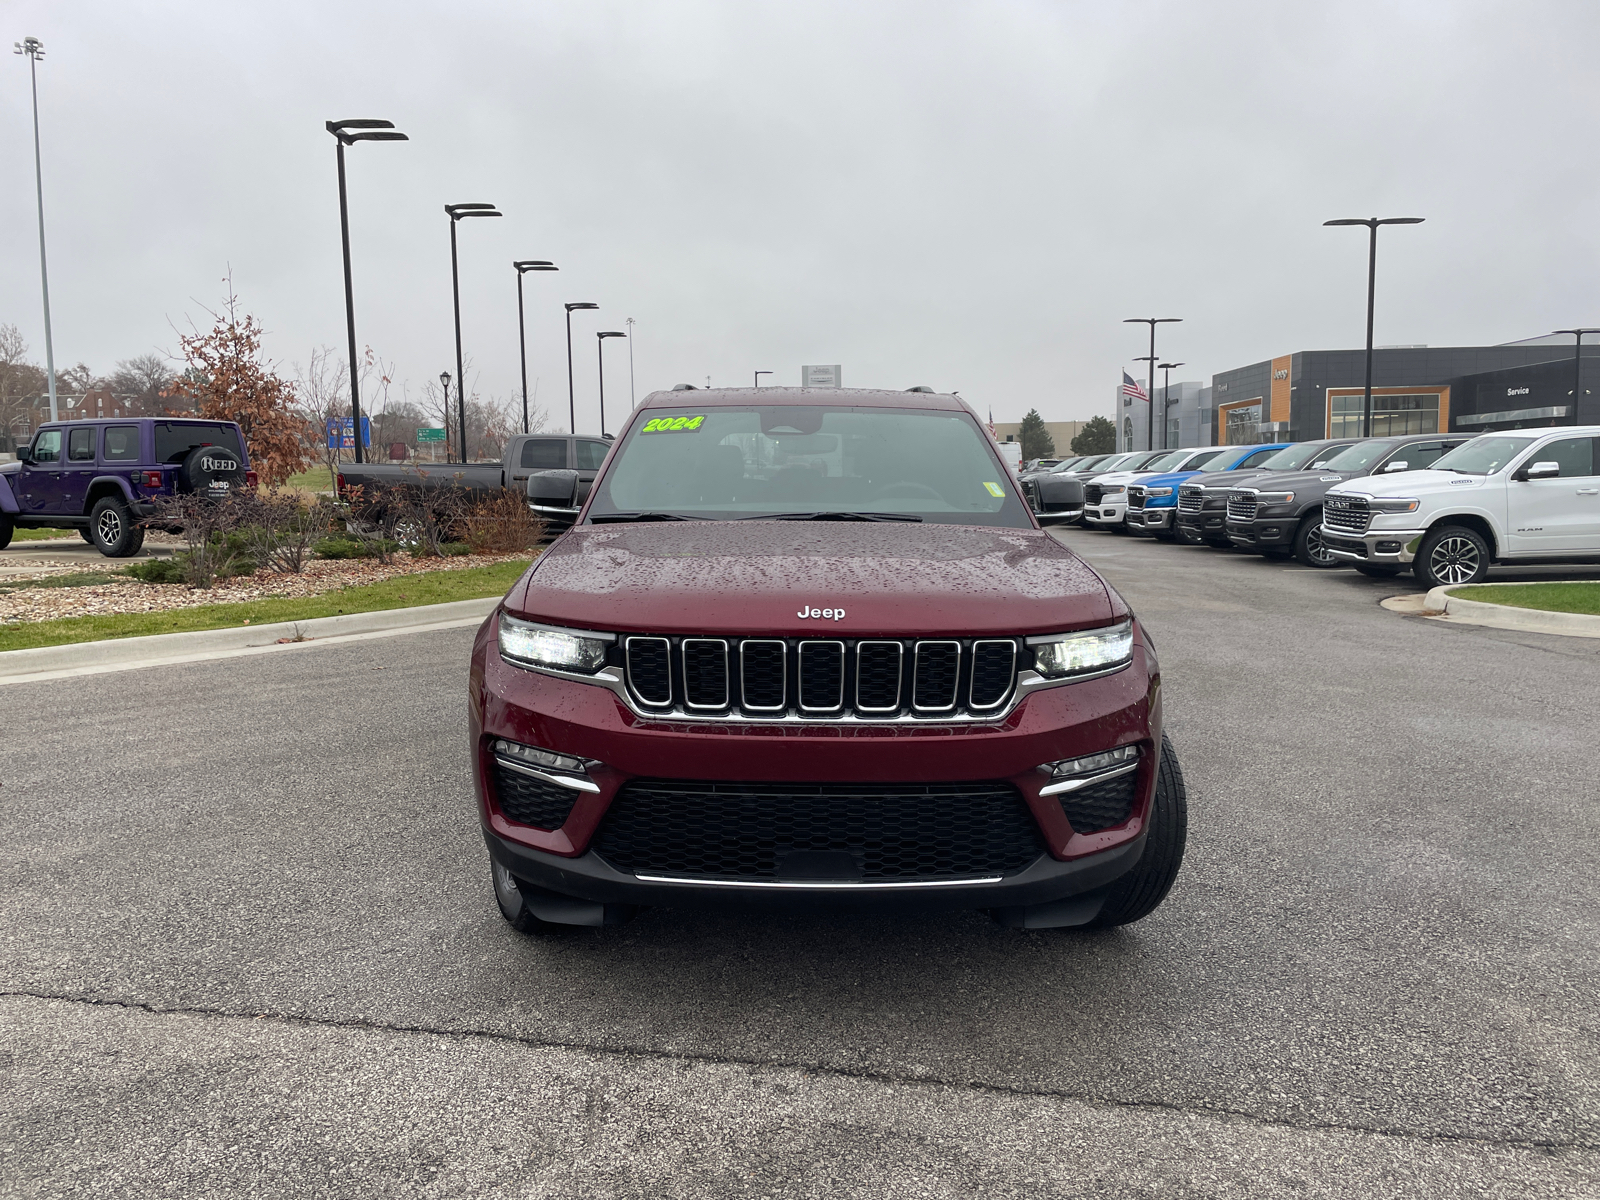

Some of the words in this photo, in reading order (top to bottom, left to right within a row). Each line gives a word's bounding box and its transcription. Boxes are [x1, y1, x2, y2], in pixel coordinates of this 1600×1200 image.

[1274, 369, 1288, 380] Jeep
[1507, 386, 1530, 396] Service
[642, 415, 705, 433] 2024
[209, 479, 229, 489] Jeep
[1328, 501, 1350, 509] RAM
[797, 605, 846, 622] Jeep
